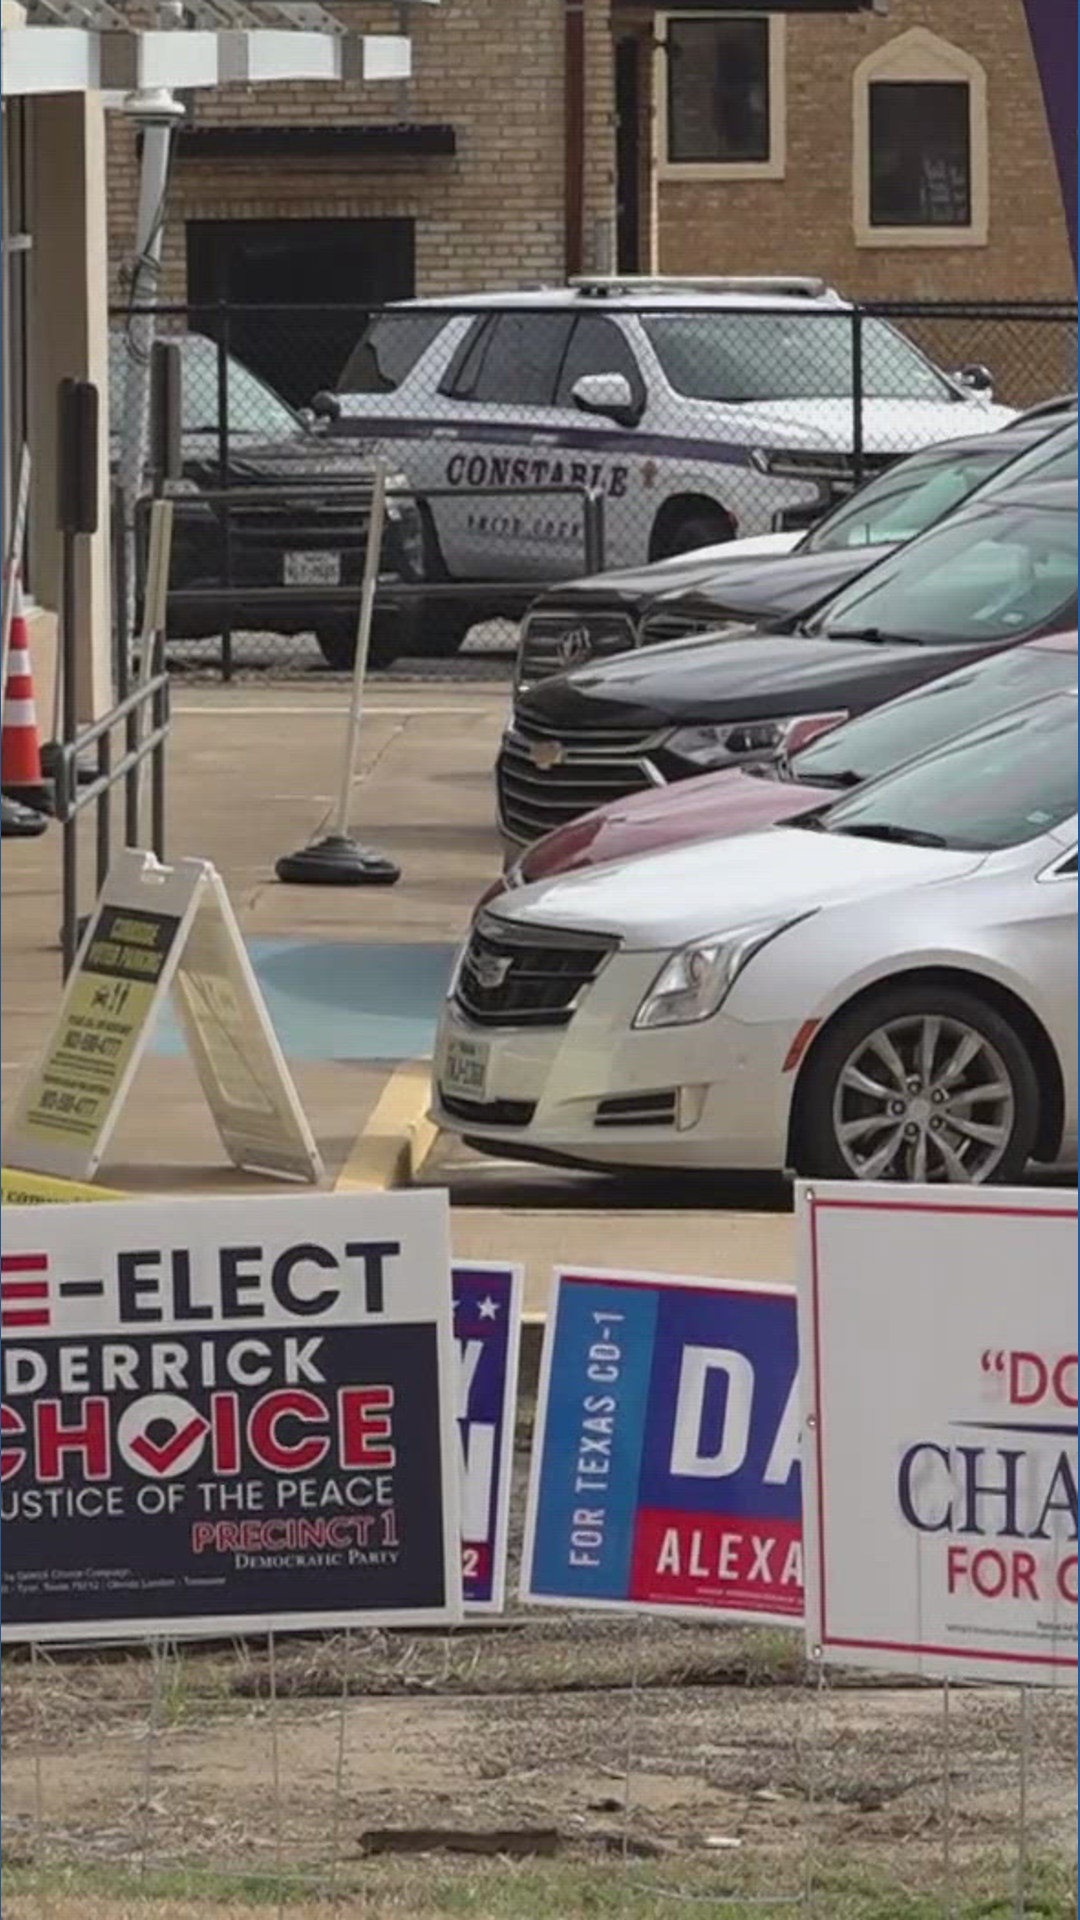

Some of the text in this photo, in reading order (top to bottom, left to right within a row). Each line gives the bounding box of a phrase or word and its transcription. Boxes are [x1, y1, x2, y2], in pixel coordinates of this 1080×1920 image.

[446, 454, 629, 498] CONSTABLE
[1, 1242, 400, 1328] E-ELECT
[4, 1336, 326, 1395] DERRICK
[569, 1311, 625, 1567] FOR TEXAS CD-1
[137, 1484, 186, 1515] OF
[198, 1481, 265, 1512] THE
[277, 1475, 395, 1509] PEACE
[898, 1442, 1079, 1540] CHA
[192, 1509, 400, 1552] PRECINCT 1
[656, 1528, 804, 1588] ALEXA
[235, 1549, 400, 1570] DEMOCRATIC PARTY
[947, 1546, 1039, 1601] FOR
